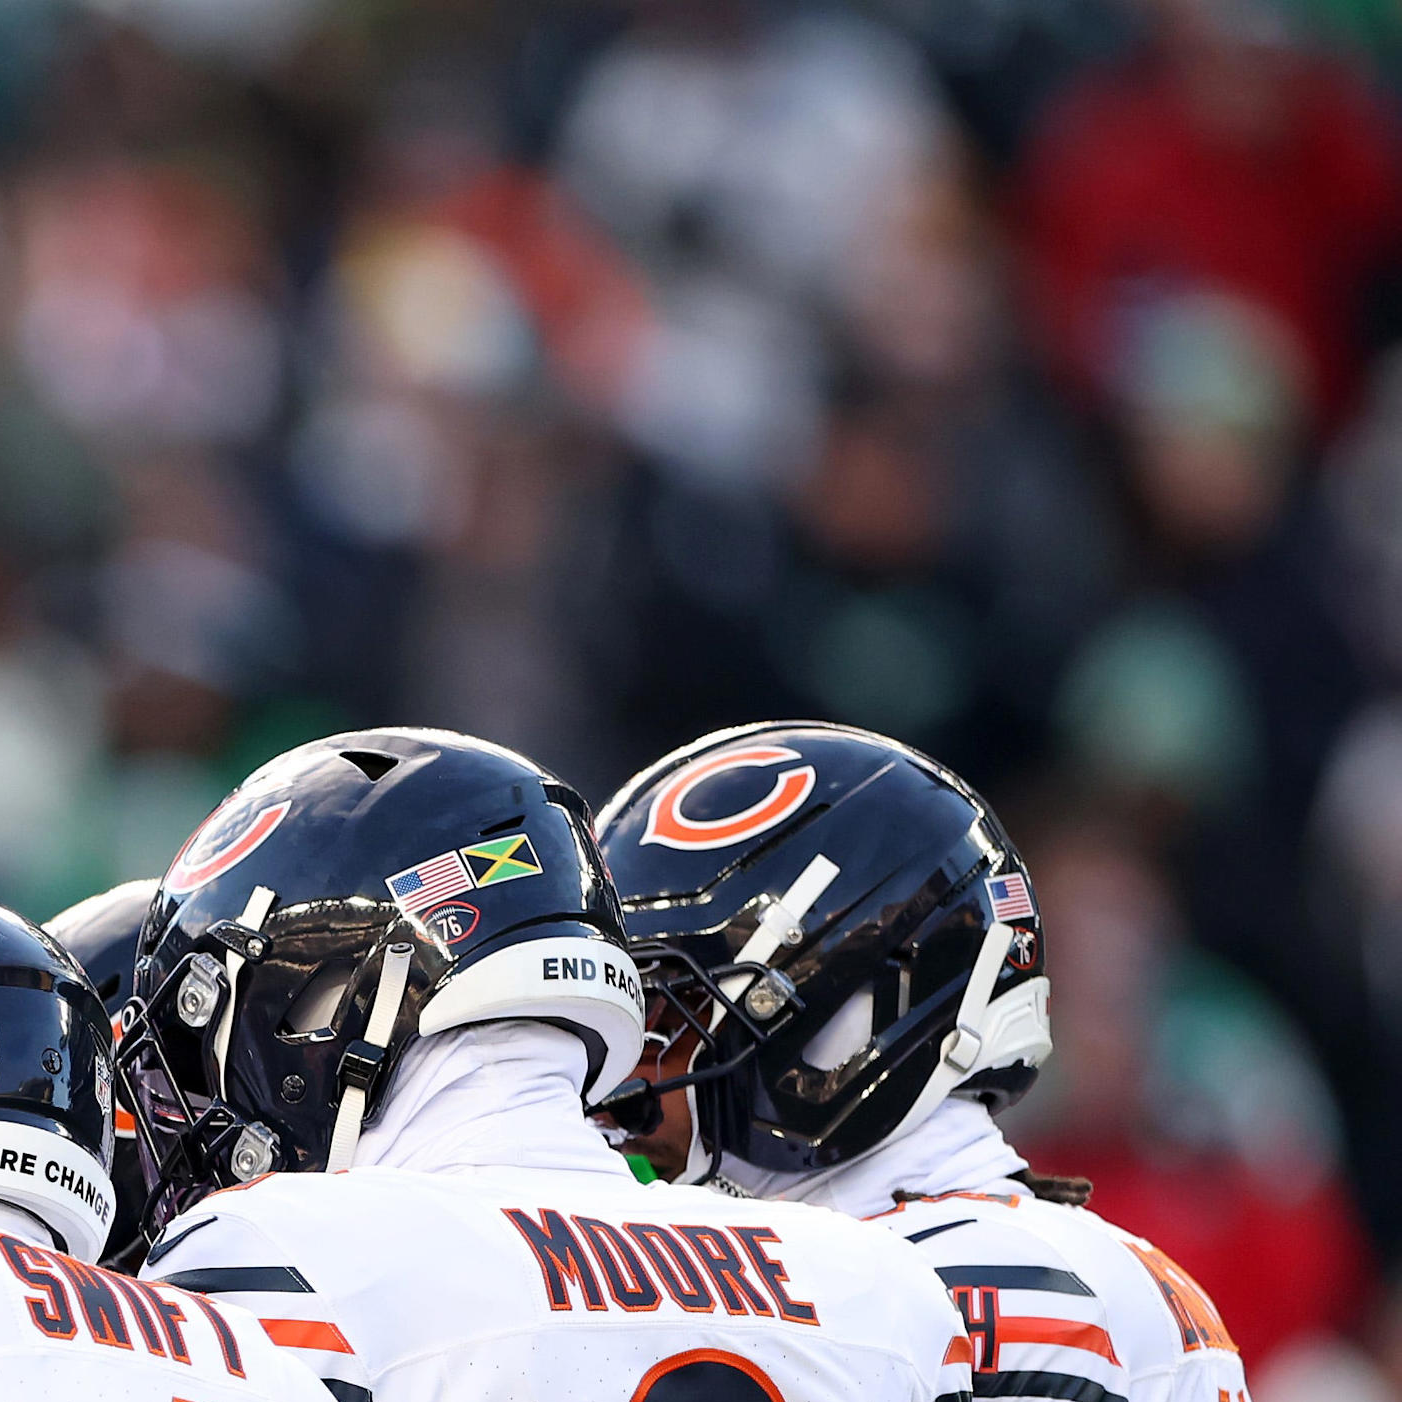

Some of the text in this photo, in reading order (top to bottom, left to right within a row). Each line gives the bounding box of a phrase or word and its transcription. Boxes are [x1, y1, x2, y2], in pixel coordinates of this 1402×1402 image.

[436, 916, 463, 940] 76
[542, 957, 597, 981] END
[44, 1160, 111, 1227] CHANGE
[502, 1207, 821, 1327] MOORE
